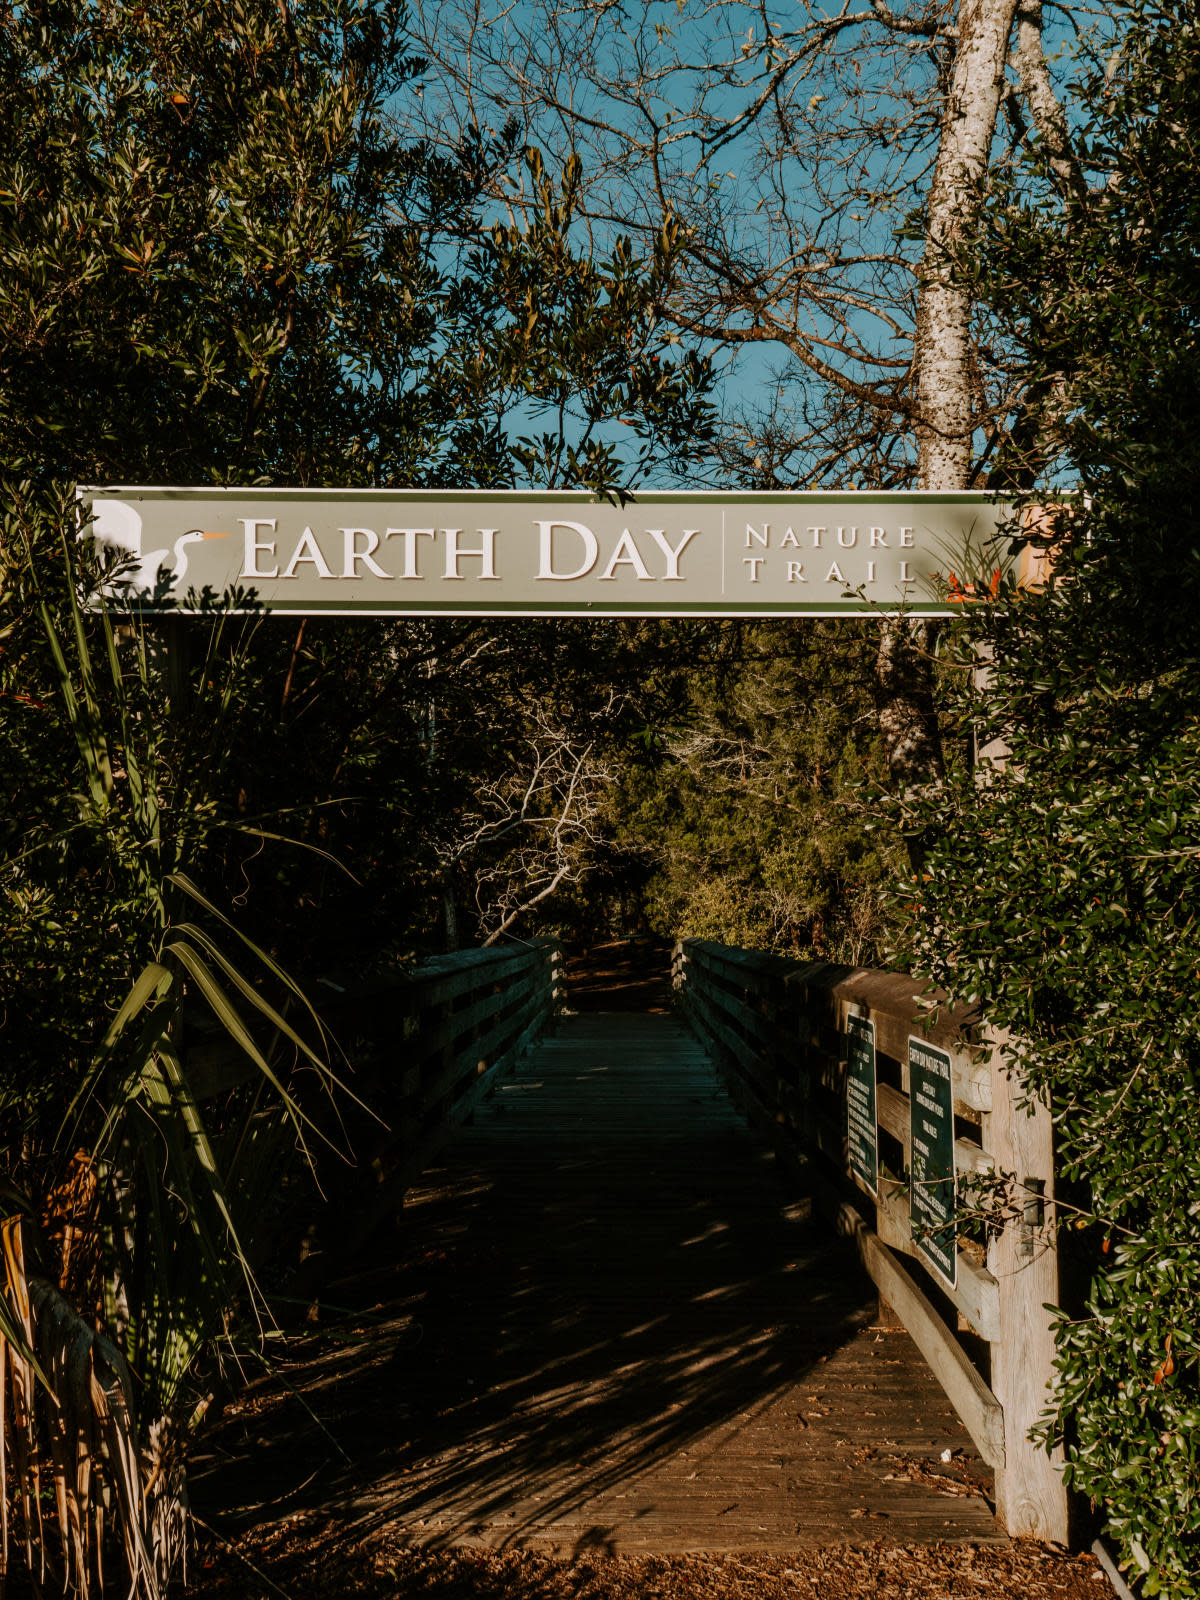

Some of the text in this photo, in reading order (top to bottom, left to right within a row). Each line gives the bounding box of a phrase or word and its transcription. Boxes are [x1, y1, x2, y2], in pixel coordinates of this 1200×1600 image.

[744, 523, 916, 549] NATURE
[236, 518, 702, 582] EARTH DAY
[742, 557, 916, 583] TRAIL
